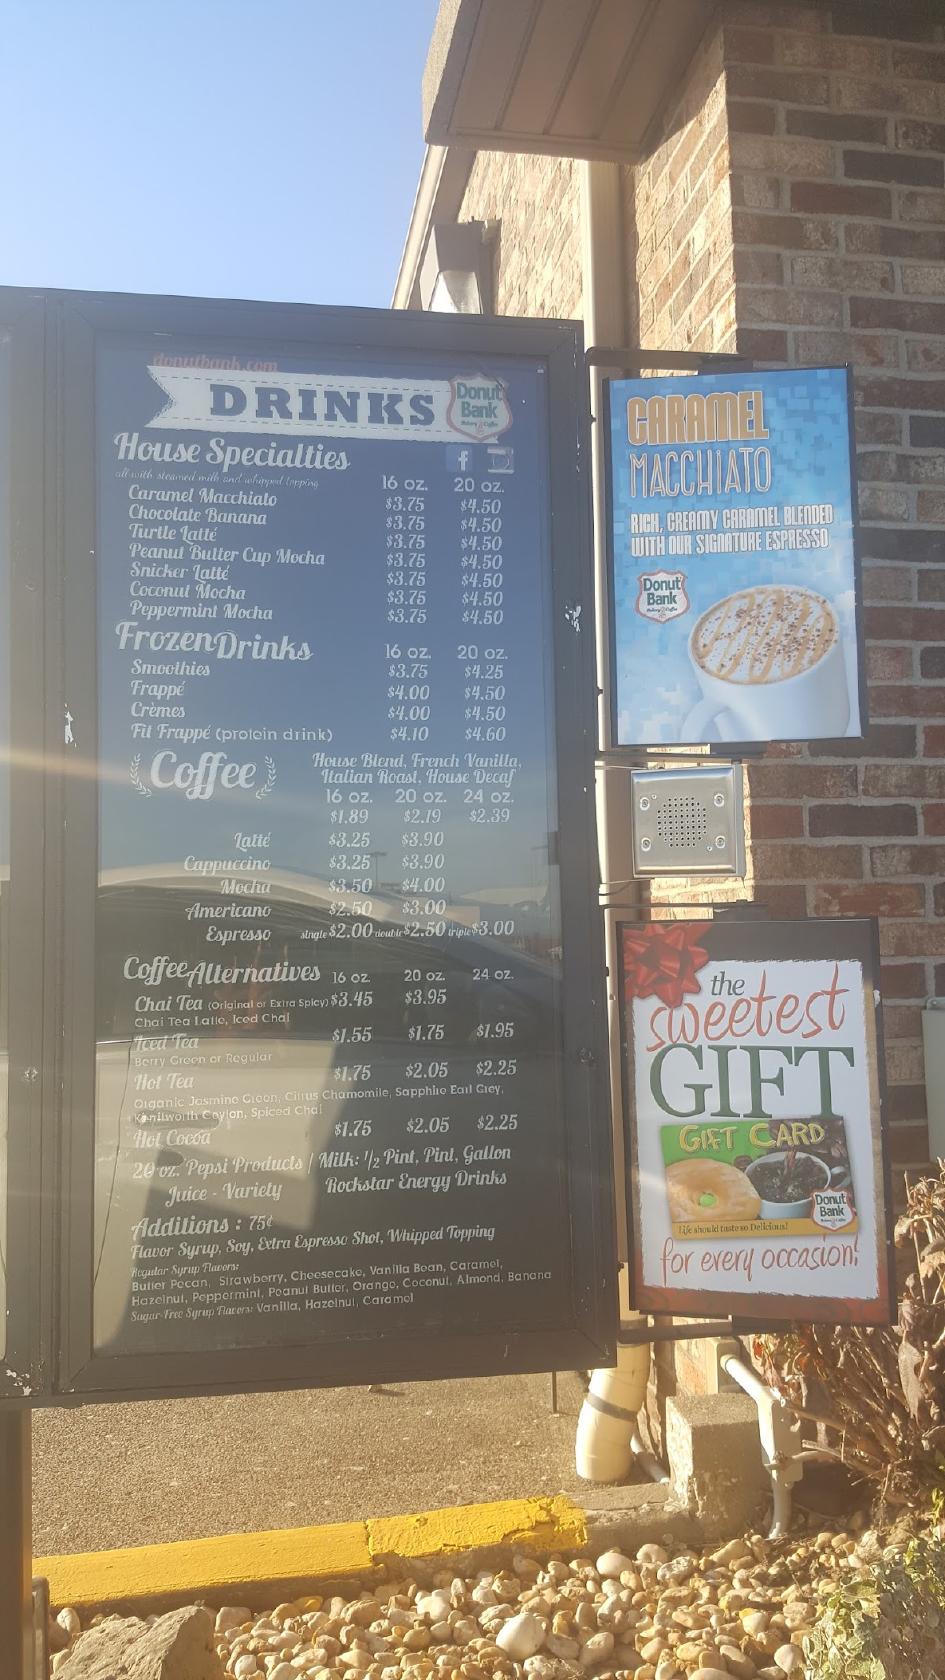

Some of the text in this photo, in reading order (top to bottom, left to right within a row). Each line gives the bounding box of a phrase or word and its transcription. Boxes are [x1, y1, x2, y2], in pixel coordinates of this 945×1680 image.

[152, 352, 279, 373] donutbank.com
[456, 382, 502, 401] Donut
[209, 383, 435, 426] DRINKS
[460, 402, 498, 418] Bank
[627, 390, 770, 446] CARAMEL
[114, 432, 350, 473] House Specialties
[382, 475, 428, 491] 16 oz.
[454, 478, 504, 493] 20 oz.
[128, 484, 278, 507] Caramel Macchiato
[386, 496, 424, 512] $3.75
[460, 498, 502, 514] $4.50
[128, 504, 268, 525] Chocolate Banana
[631, 504, 834, 534] RICH, CREAMY CARAMEL BLENDED
[128, 523, 218, 545] Turtle Latté
[386, 534, 426, 549] $3.75
[460, 536, 502, 550] $4.50
[632, 531, 762, 558] WITH OUR SIGNATURE
[128, 542, 326, 566] Peanut Butter Cup Mocha
[130, 562, 230, 584] Snicker Latté
[386, 571, 426, 586] $3.75
[462, 572, 503, 588] $4.50
[130, 581, 246, 600] Coconut Mocha
[643, 576, 682, 592] Donut
[646, 592, 678, 606] Bank
[130, 600, 273, 620] Peppermint Mocha
[388, 608, 427, 624] $3.75
[462, 610, 504, 624] $4.50
[384, 644, 432, 660] 16 oz.
[457, 645, 508, 660] 20 oz.
[130, 659, 210, 676] Smoothies
[464, 664, 504, 680] $4.25
[388, 685, 430, 700] $4.00
[388, 706, 431, 721] $4.00
[464, 706, 506, 721] $4.50
[216, 728, 278, 742] (protein
[390, 726, 430, 742] $4.10
[464, 726, 506, 742] $4.60
[312, 752, 358, 768] House
[150, 750, 258, 800] Coffee
[426, 769, 517, 788] House Decaf
[326, 789, 373, 804] 16 oz.
[395, 788, 447, 803] 20 oz.
[464, 789, 514, 803] 24 oz.
[330, 808, 368, 824] $1.89
[328, 832, 370, 848] $3.25
[402, 832, 444, 847] $3.90
[184, 856, 272, 876] Cappuccino
[328, 855, 371, 870] $3.25
[402, 854, 445, 870] $3.90
[220, 879, 272, 894] Mocha
[402, 878, 446, 893] $4.00
[184, 902, 272, 920] Americano
[402, 900, 446, 915] $3.00
[206, 926, 272, 946] Espresso
[332, 972, 371, 984] 16 oz.
[404, 969, 446, 982] 20 oz.
[472, 968, 514, 981] 24 oz.
[711, 970, 746, 996] the
[135, 994, 330, 1012] Chai Tea (Original Extra Spicy)
[646, 962, 850, 1052] sweetest
[134, 1012, 290, 1028] Chai Tea Iced Chai
[332, 1026, 372, 1043] $1.55
[408, 1024, 445, 1040] $1.75
[476, 1022, 514, 1038] $1.95
[170, 1054, 208, 1066] Green
[476, 1060, 517, 1076] $2.25
[334, 1065, 372, 1082] $1.75
[406, 1062, 448, 1078] $2.05
[168, 1072, 194, 1090] Tea
[650, 1042, 854, 1119] GIFT
[189, 1096, 239, 1107] Jasmine
[450, 1085, 472, 1095] Earl
[251, 1104, 322, 1118] Spiced Chai
[334, 1120, 372, 1137] $1.75
[406, 1116, 450, 1134] $2.05
[477, 1114, 518, 1131] $2.25
[166, 1129, 211, 1146] Cocoa
[679, 1122, 826, 1152] GIFT CARD
[326, 1170, 508, 1194] Rockstar Drinks
[165, 1186, 208, 1208] Juice
[815, 1194, 847, 1206] Donut
[820, 1206, 844, 1218] Bank
[249, 1214, 274, 1232] 75¢
[694, 1224, 719, 1234] should
[130, 1224, 496, 1260] Flavor Extra Whipped Topping
[660, 1234, 859, 1288] for every occasion!
[132, 1280, 166, 1292] Butter
[370, 1264, 410, 1275] Vanilla
[268, 1286, 308, 1297] Peanut
[508, 1270, 552, 1282] Banana
[363, 1293, 414, 1306] Caramel
